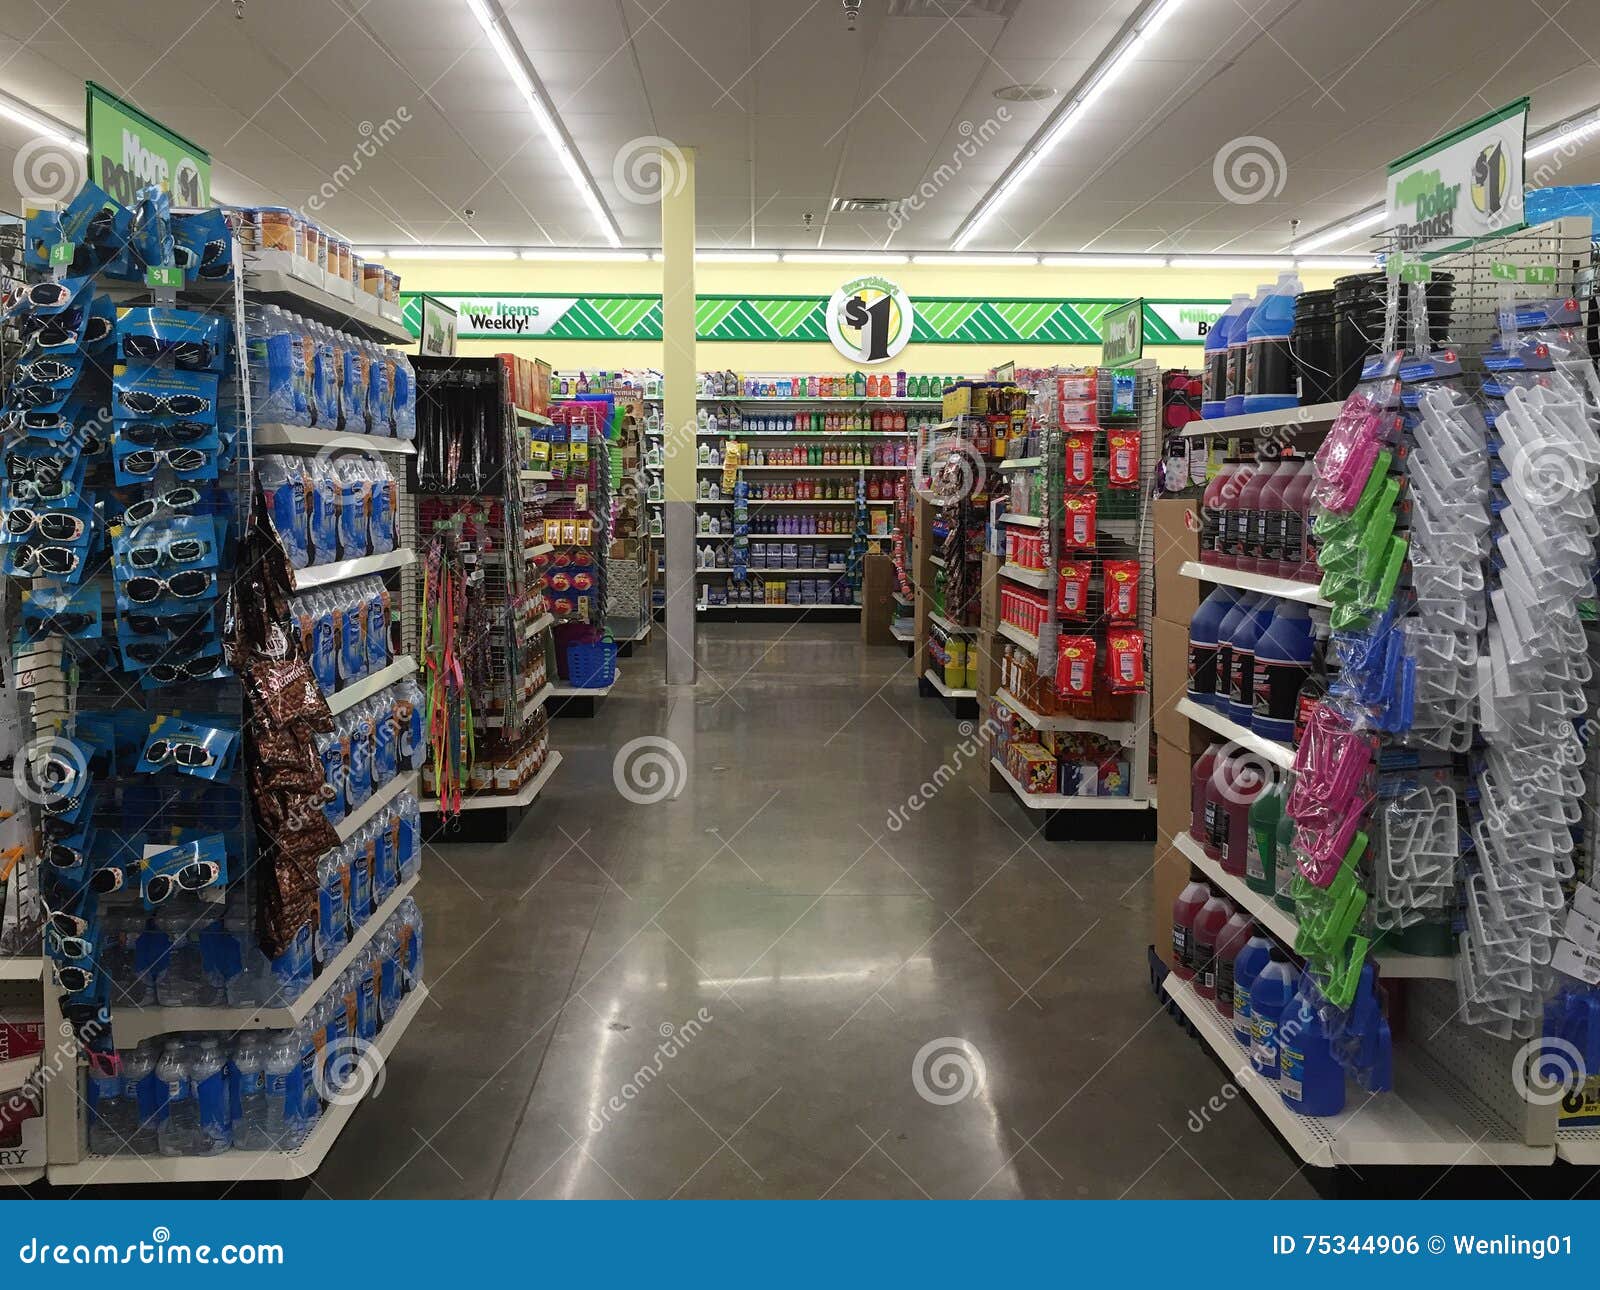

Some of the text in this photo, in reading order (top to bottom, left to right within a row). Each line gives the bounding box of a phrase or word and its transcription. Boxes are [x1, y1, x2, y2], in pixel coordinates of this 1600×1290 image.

[123, 127, 168, 186] More
[1416, 182, 1461, 223] Dollar
[460, 301, 540, 317] New Items
[470, 314, 529, 334] Weekly!
[845, 295, 892, 361] $1
